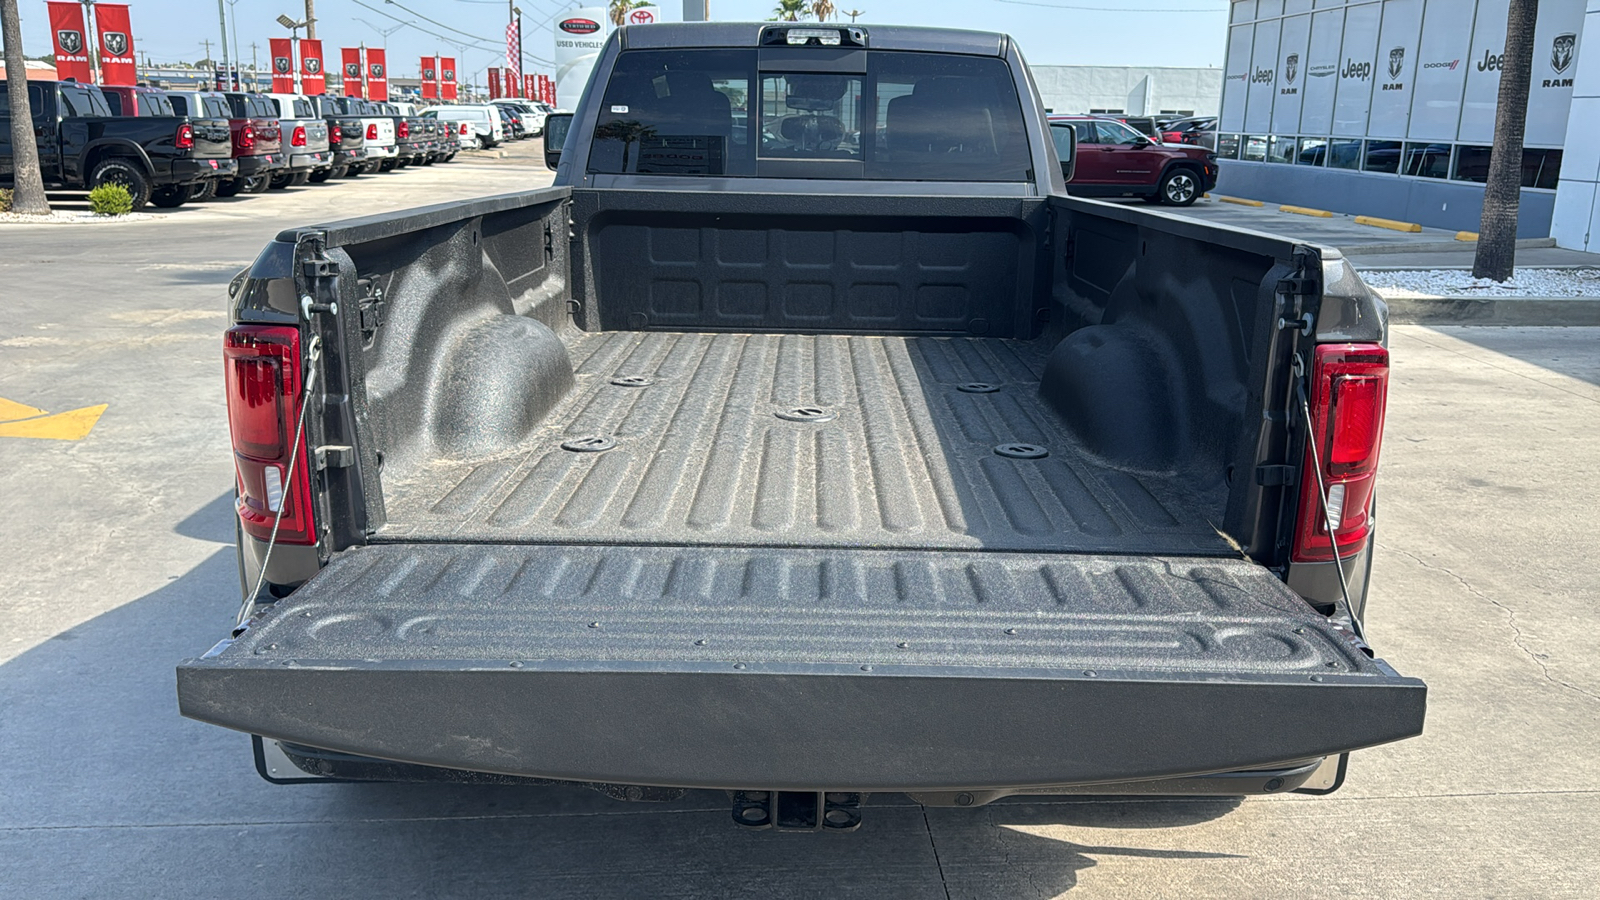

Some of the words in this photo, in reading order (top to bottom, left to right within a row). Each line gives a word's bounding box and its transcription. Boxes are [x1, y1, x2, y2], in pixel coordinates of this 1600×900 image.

[1342, 58, 1370, 81] Jeep
[1477, 49, 1504, 72] Jee
[1252, 65, 1273, 86] Jeep
[1542, 79, 1573, 88] RAM
[1382, 83, 1403, 91] RAM
